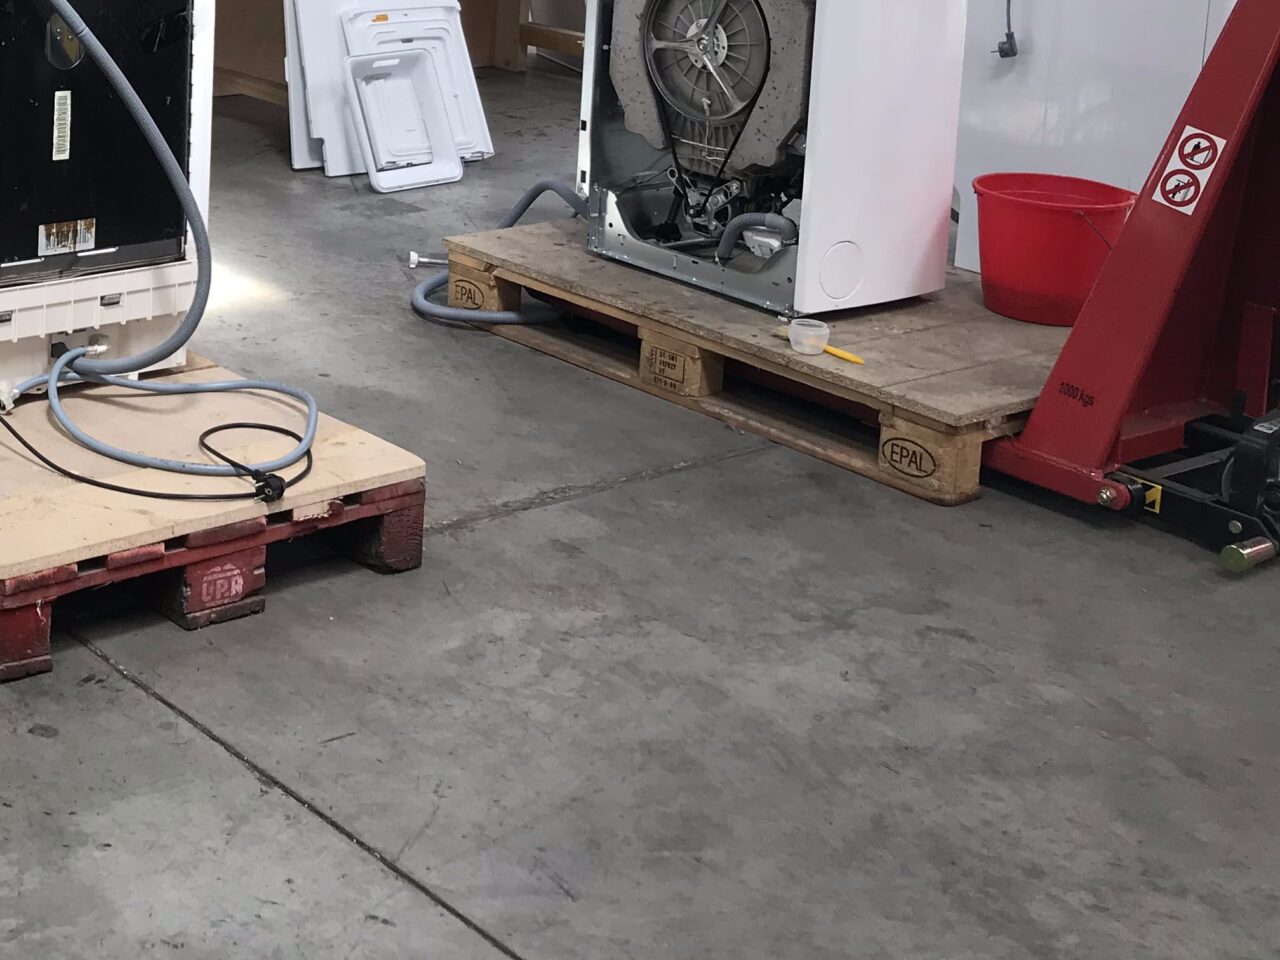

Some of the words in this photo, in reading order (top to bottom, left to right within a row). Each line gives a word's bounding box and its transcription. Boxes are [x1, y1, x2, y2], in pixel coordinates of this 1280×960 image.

[455, 284, 480, 307] EPAL
[1080, 389, 1096, 407] kgs
[890, 442, 929, 474] EPAL
